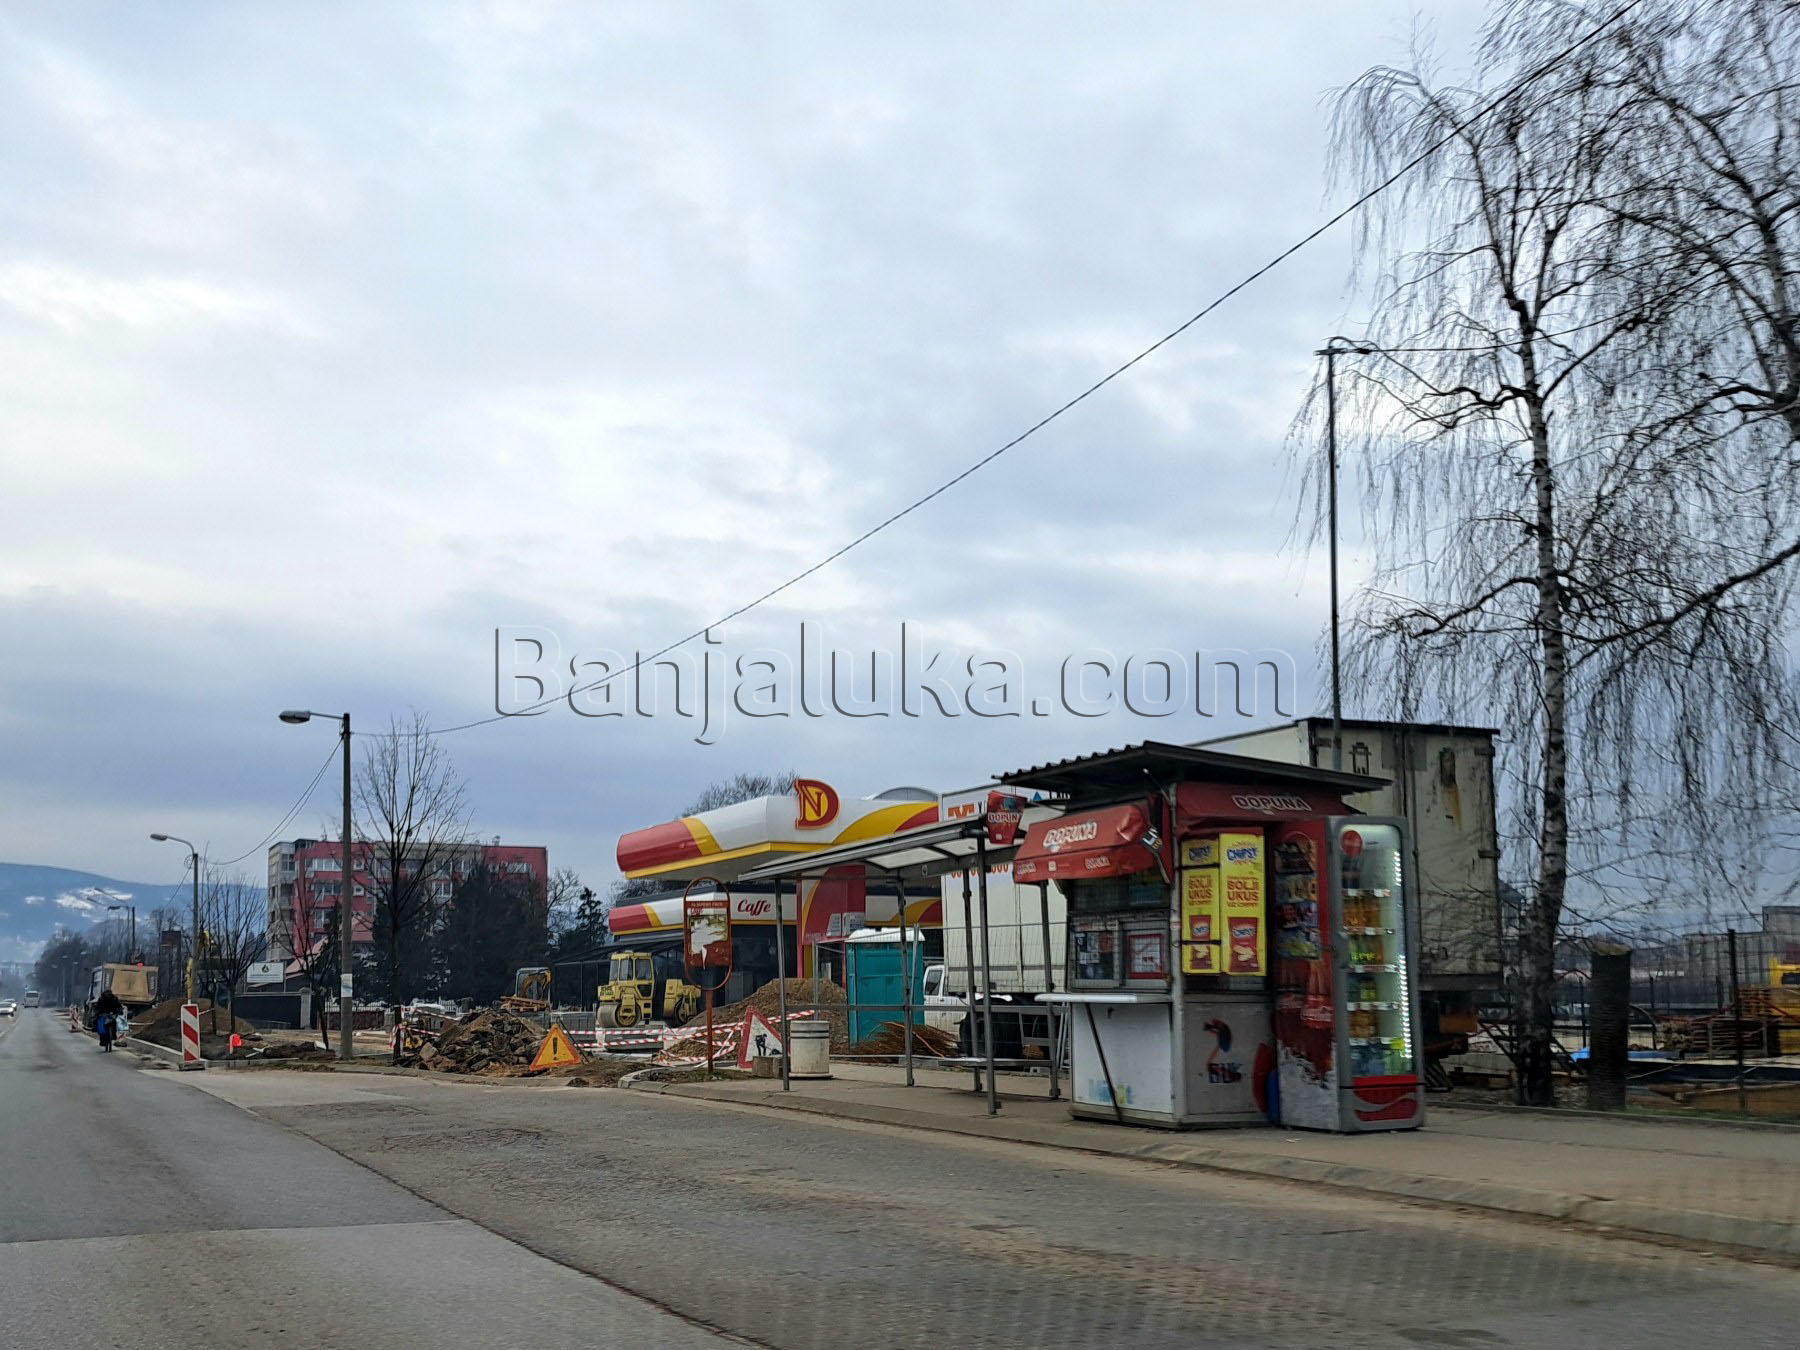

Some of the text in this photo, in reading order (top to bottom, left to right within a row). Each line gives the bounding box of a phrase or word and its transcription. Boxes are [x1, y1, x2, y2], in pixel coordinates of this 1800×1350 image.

[1232, 795, 1312, 811] DOPUNA
[987, 811, 1022, 824] DOPUN
[1043, 821, 1098, 848] DOPUNA
[1227, 880, 1260, 891] BOLJI
[1188, 889, 1212, 900] UKUS
[1227, 890, 1260, 901] UKUS
[737, 899, 771, 917] Caffe
